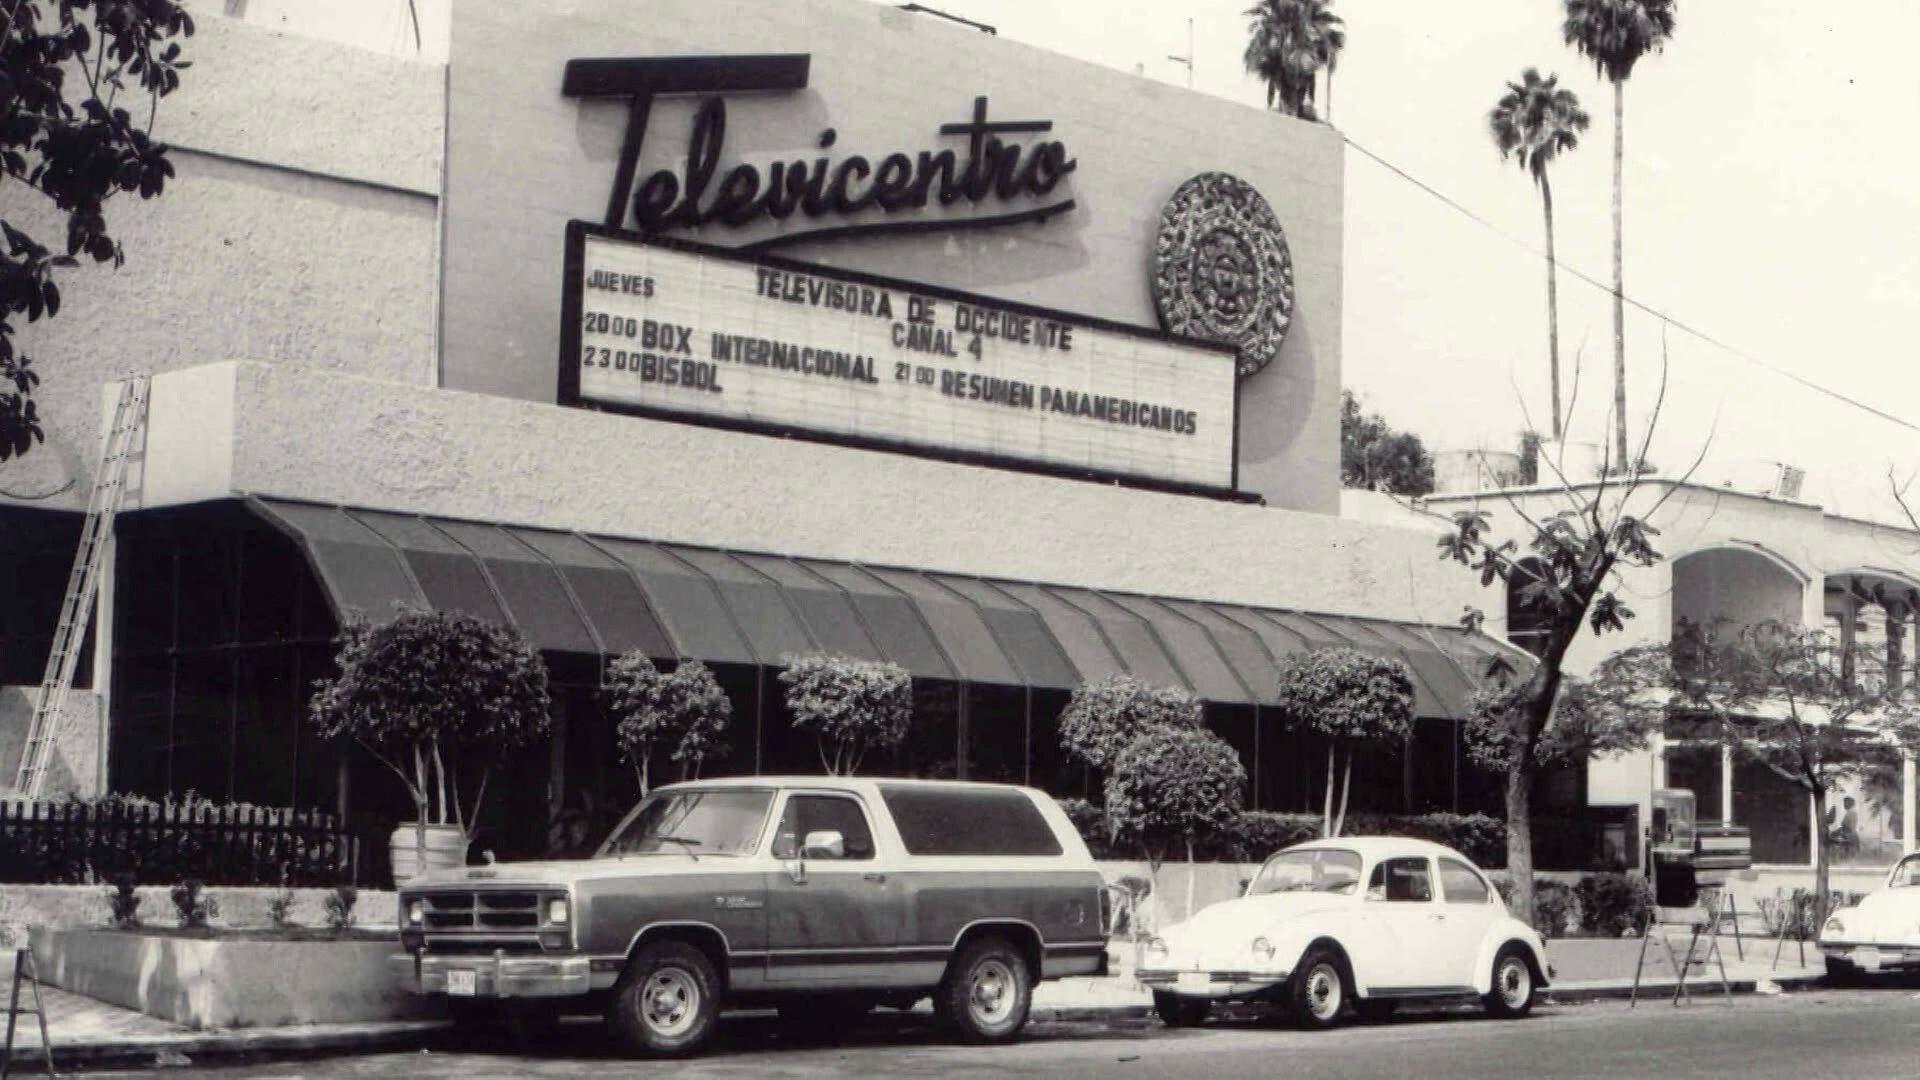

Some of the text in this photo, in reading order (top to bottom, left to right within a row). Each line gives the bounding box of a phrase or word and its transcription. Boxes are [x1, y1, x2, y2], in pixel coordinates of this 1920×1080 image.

[562, 53, 1077, 233] Televicentro
[587, 270, 654, 298] JUEVES
[757, 268, 1073, 351] TELEVISORA DE OCCIDENTE
[892, 322, 982, 361] CANAL 4
[640, 354, 723, 393] BISBOL
[641, 320, 692, 354] BOX
[711, 333, 878, 383] INTERNACIONAL
[942, 370, 1034, 409] RESUMEN
[1040, 385, 1197, 435] PANAMERICANOS
